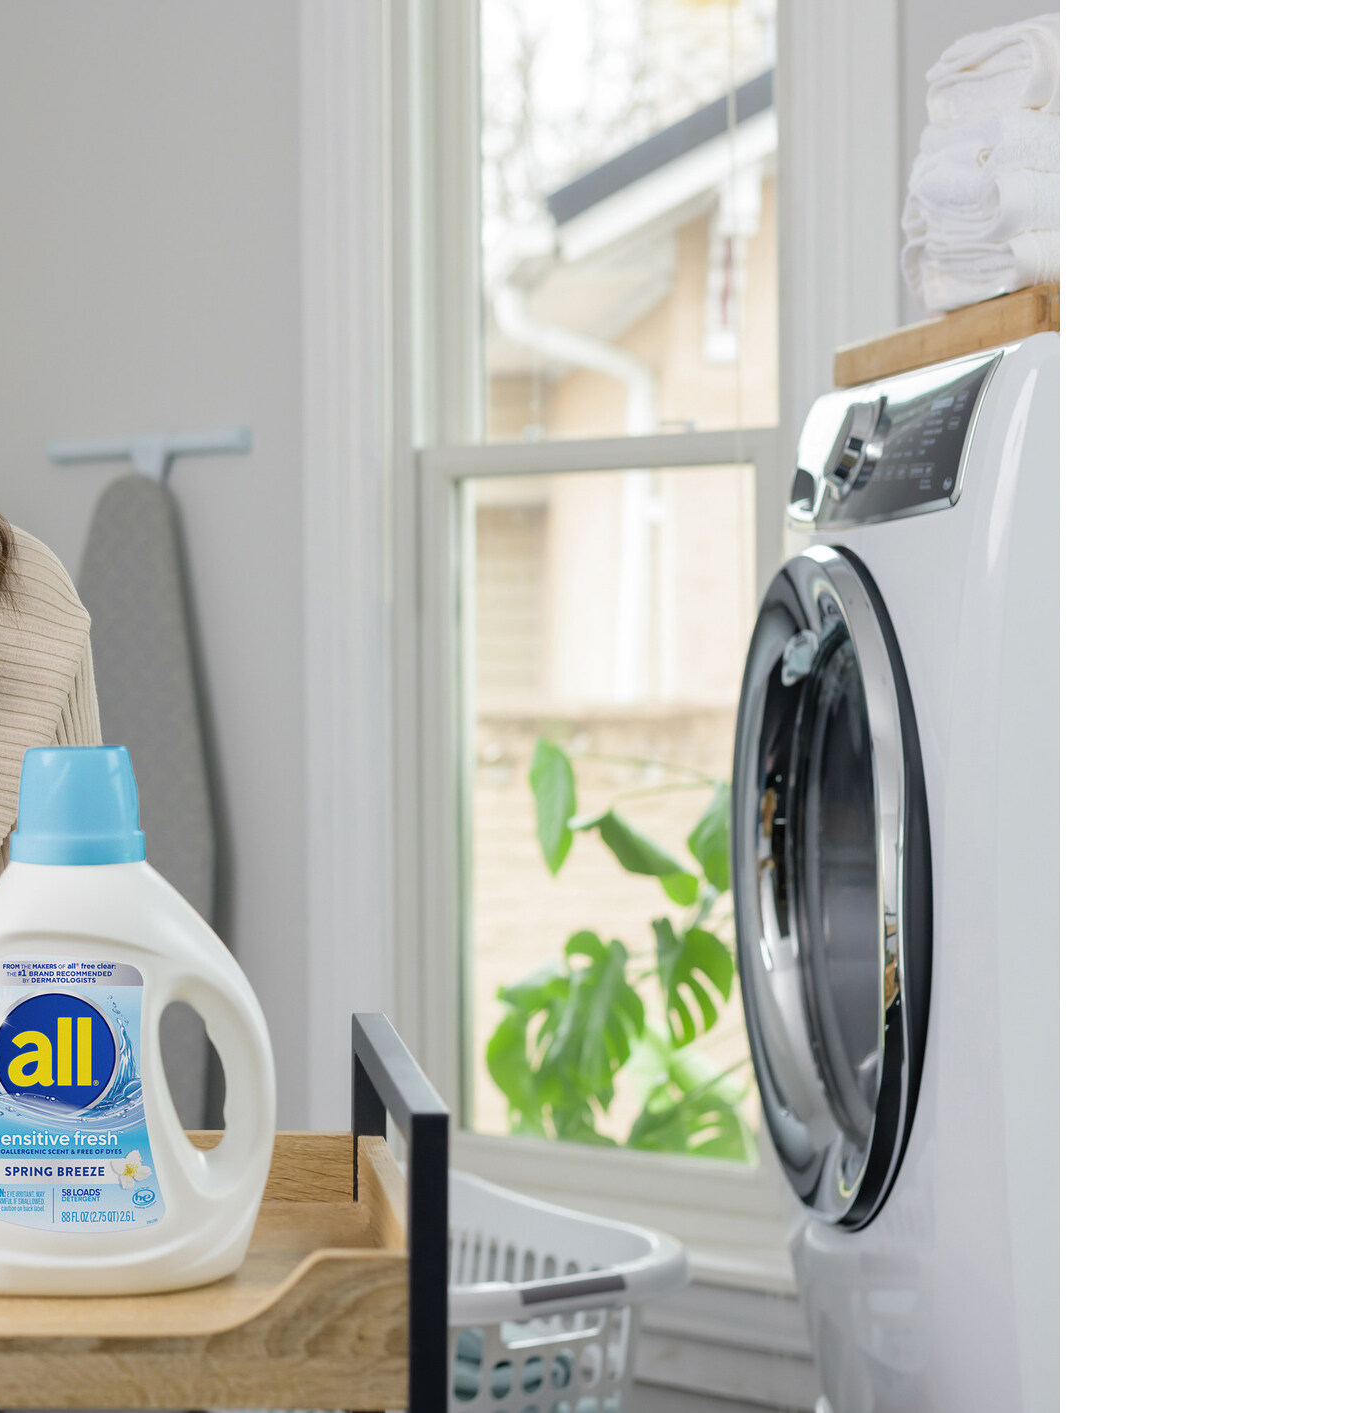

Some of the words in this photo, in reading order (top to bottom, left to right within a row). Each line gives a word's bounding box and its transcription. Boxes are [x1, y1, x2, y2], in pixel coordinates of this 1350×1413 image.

[17, 969, 27, 977] #1
[4, 1166, 53, 1177] SPRING
[57, 1166, 105, 1177] BREEZE
[61, 1188, 71, 1196] 58
[61, 1211, 71, 1222] 88
[71, 1211, 79, 1222] FL
[80, 1211, 90, 1222] OZ
[90, 1210, 107, 1223] (2.75
[107, 1210, 119, 1223] QT)
[120, 1210, 131, 1222] 2.6
[131, 1210, 136, 1222] L
